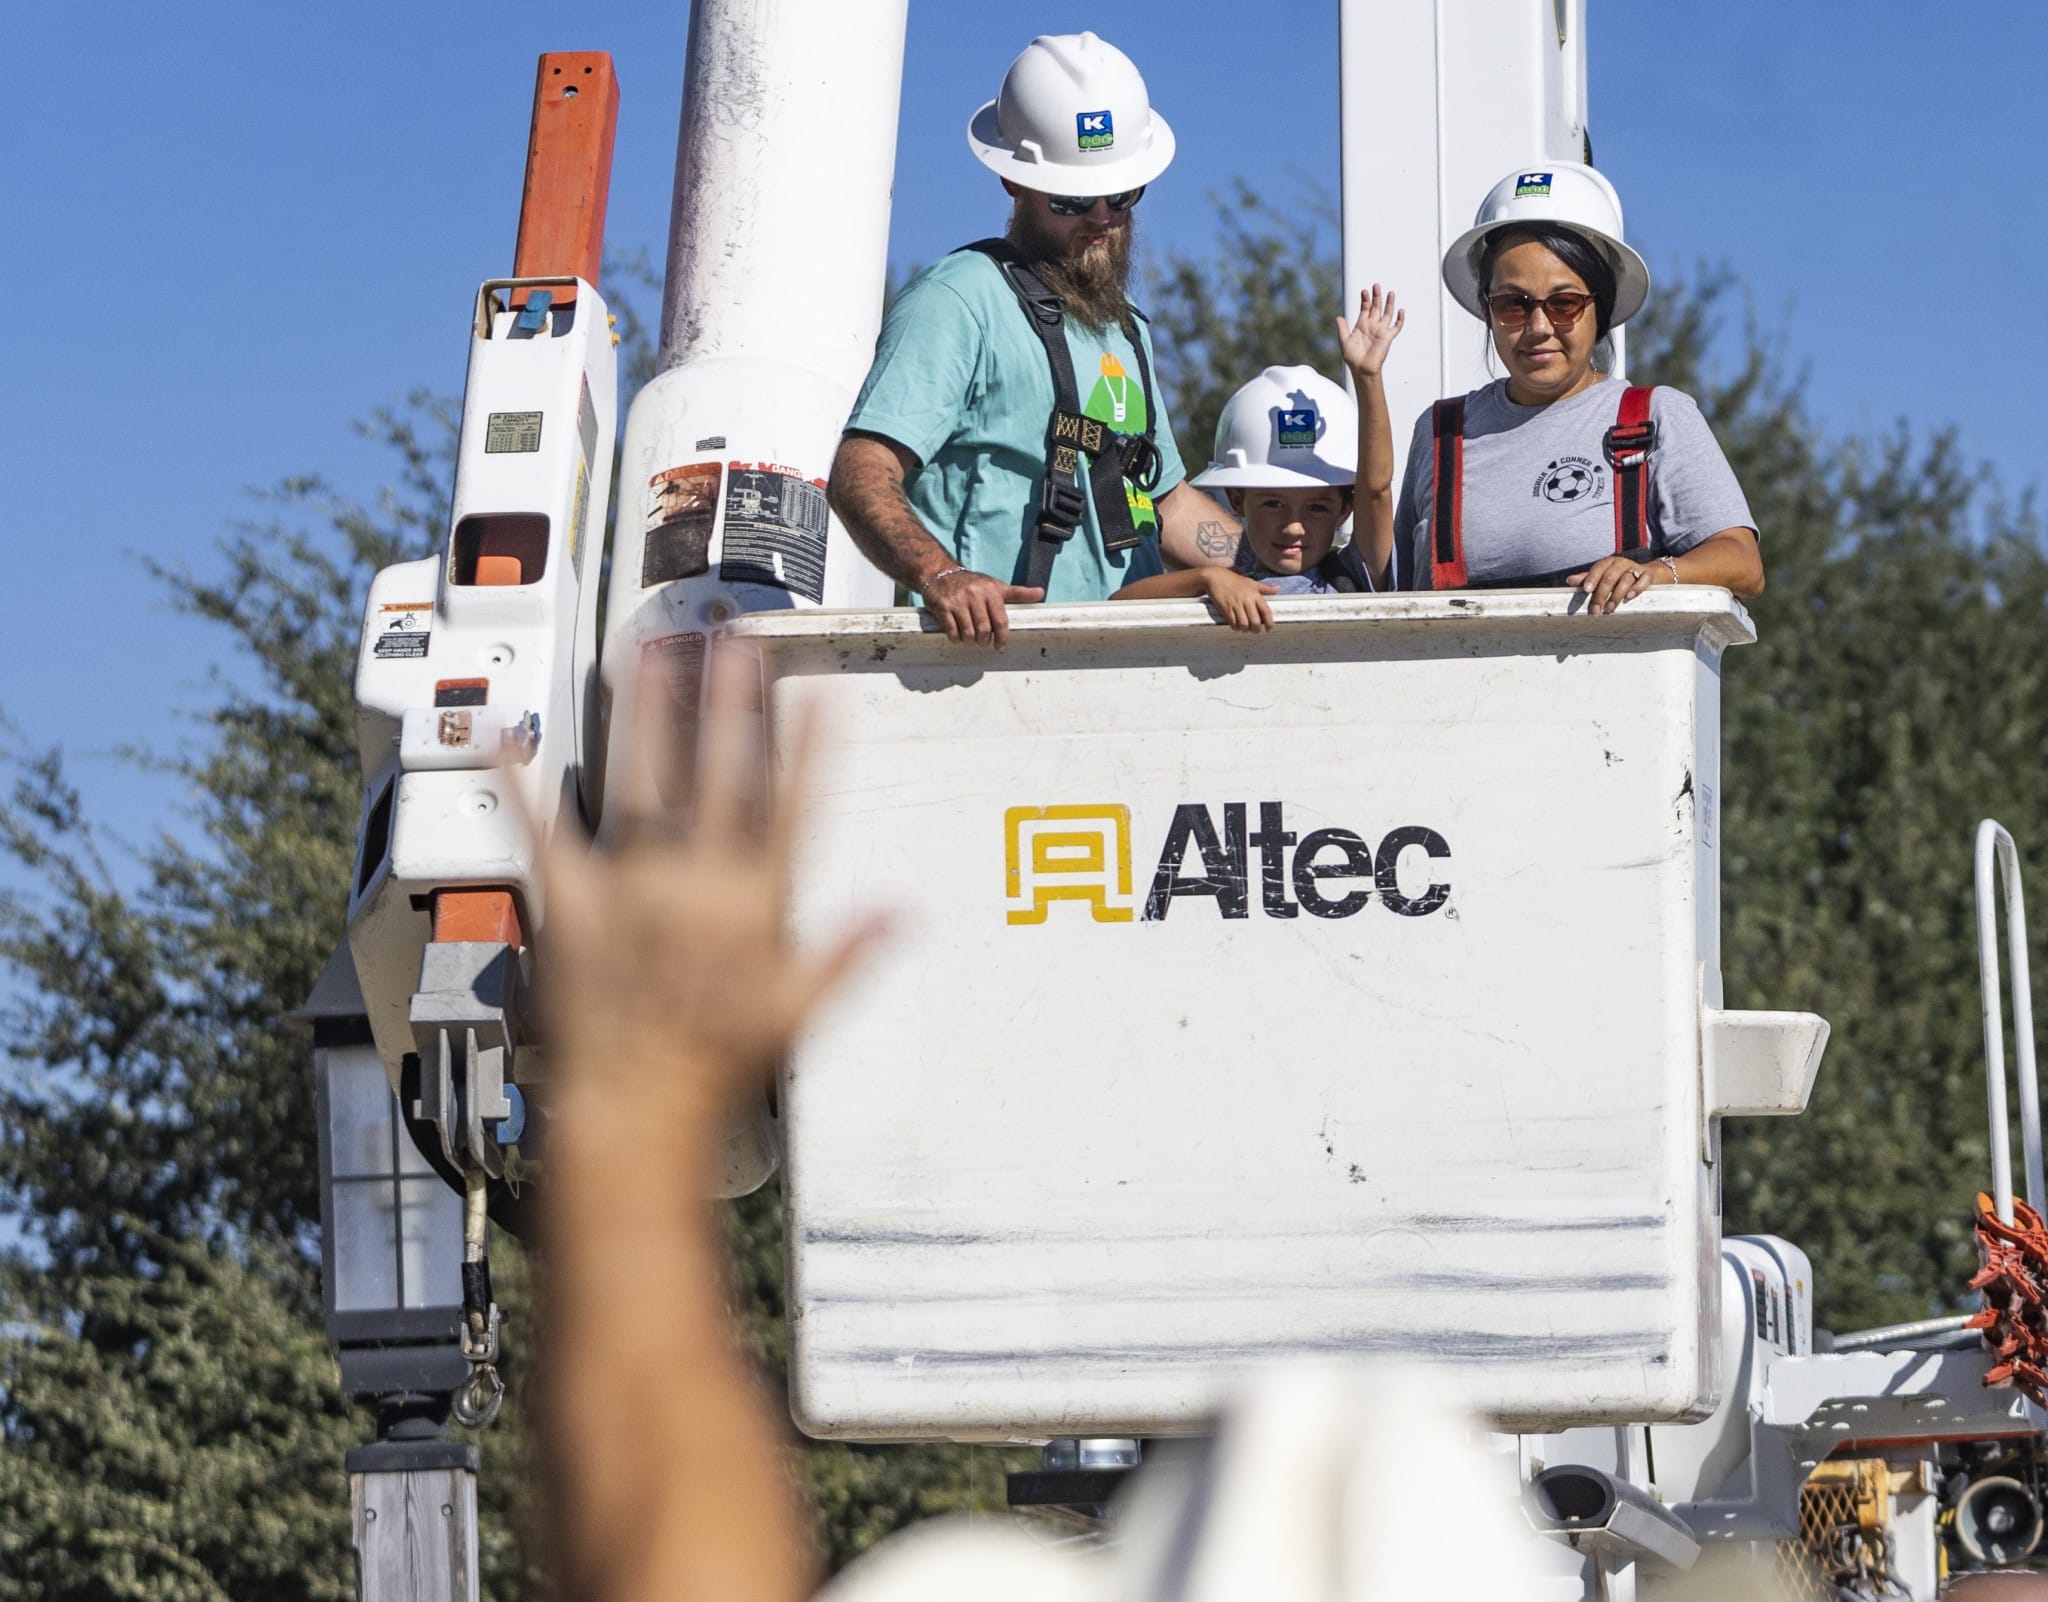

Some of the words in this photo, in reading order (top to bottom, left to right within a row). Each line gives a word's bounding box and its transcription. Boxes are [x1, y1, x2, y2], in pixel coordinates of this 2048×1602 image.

[1083, 116, 1105, 130] K
[1524, 174, 1544, 184] K
[1284, 414, 1307, 426] K
[1560, 456, 1593, 467] CONNER
[1140, 801, 1452, 922] Altec
